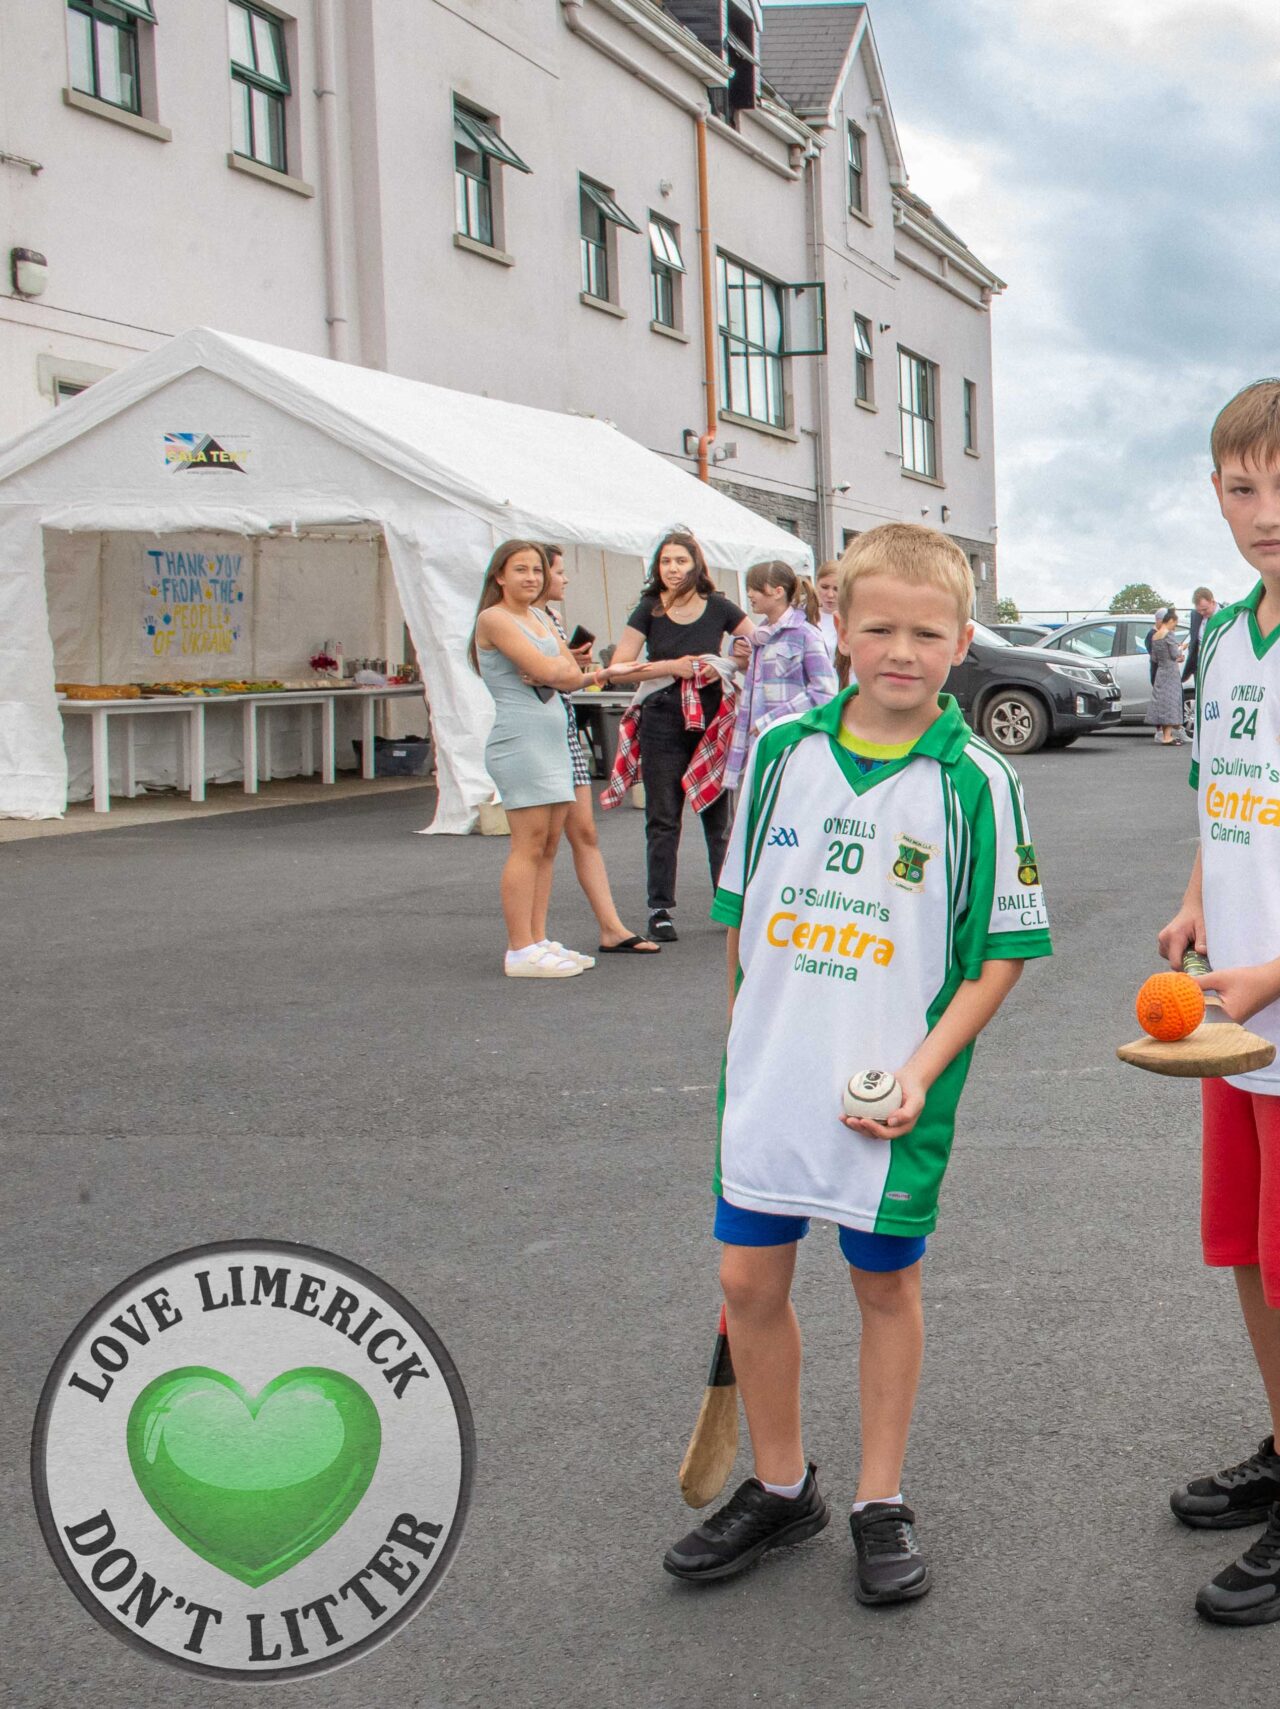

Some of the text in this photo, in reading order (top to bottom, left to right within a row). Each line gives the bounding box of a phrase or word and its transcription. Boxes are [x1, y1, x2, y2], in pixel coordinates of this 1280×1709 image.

[147, 550, 241, 577] THANK YOU
[162, 578, 236, 604] FROM THE
[173, 603, 224, 630] PEOPLE
[153, 630, 175, 655] OF
[1230, 707, 1258, 741] 24
[823, 817, 877, 840] O'NEILLS
[1211, 822, 1250, 845] Clarina
[826, 841, 864, 875] 20
[780, 886, 890, 923] O'Sullivan's
[997, 892, 1037, 911] BAILE
[766, 911, 896, 967] Centra
[794, 953, 858, 982] Clarina
